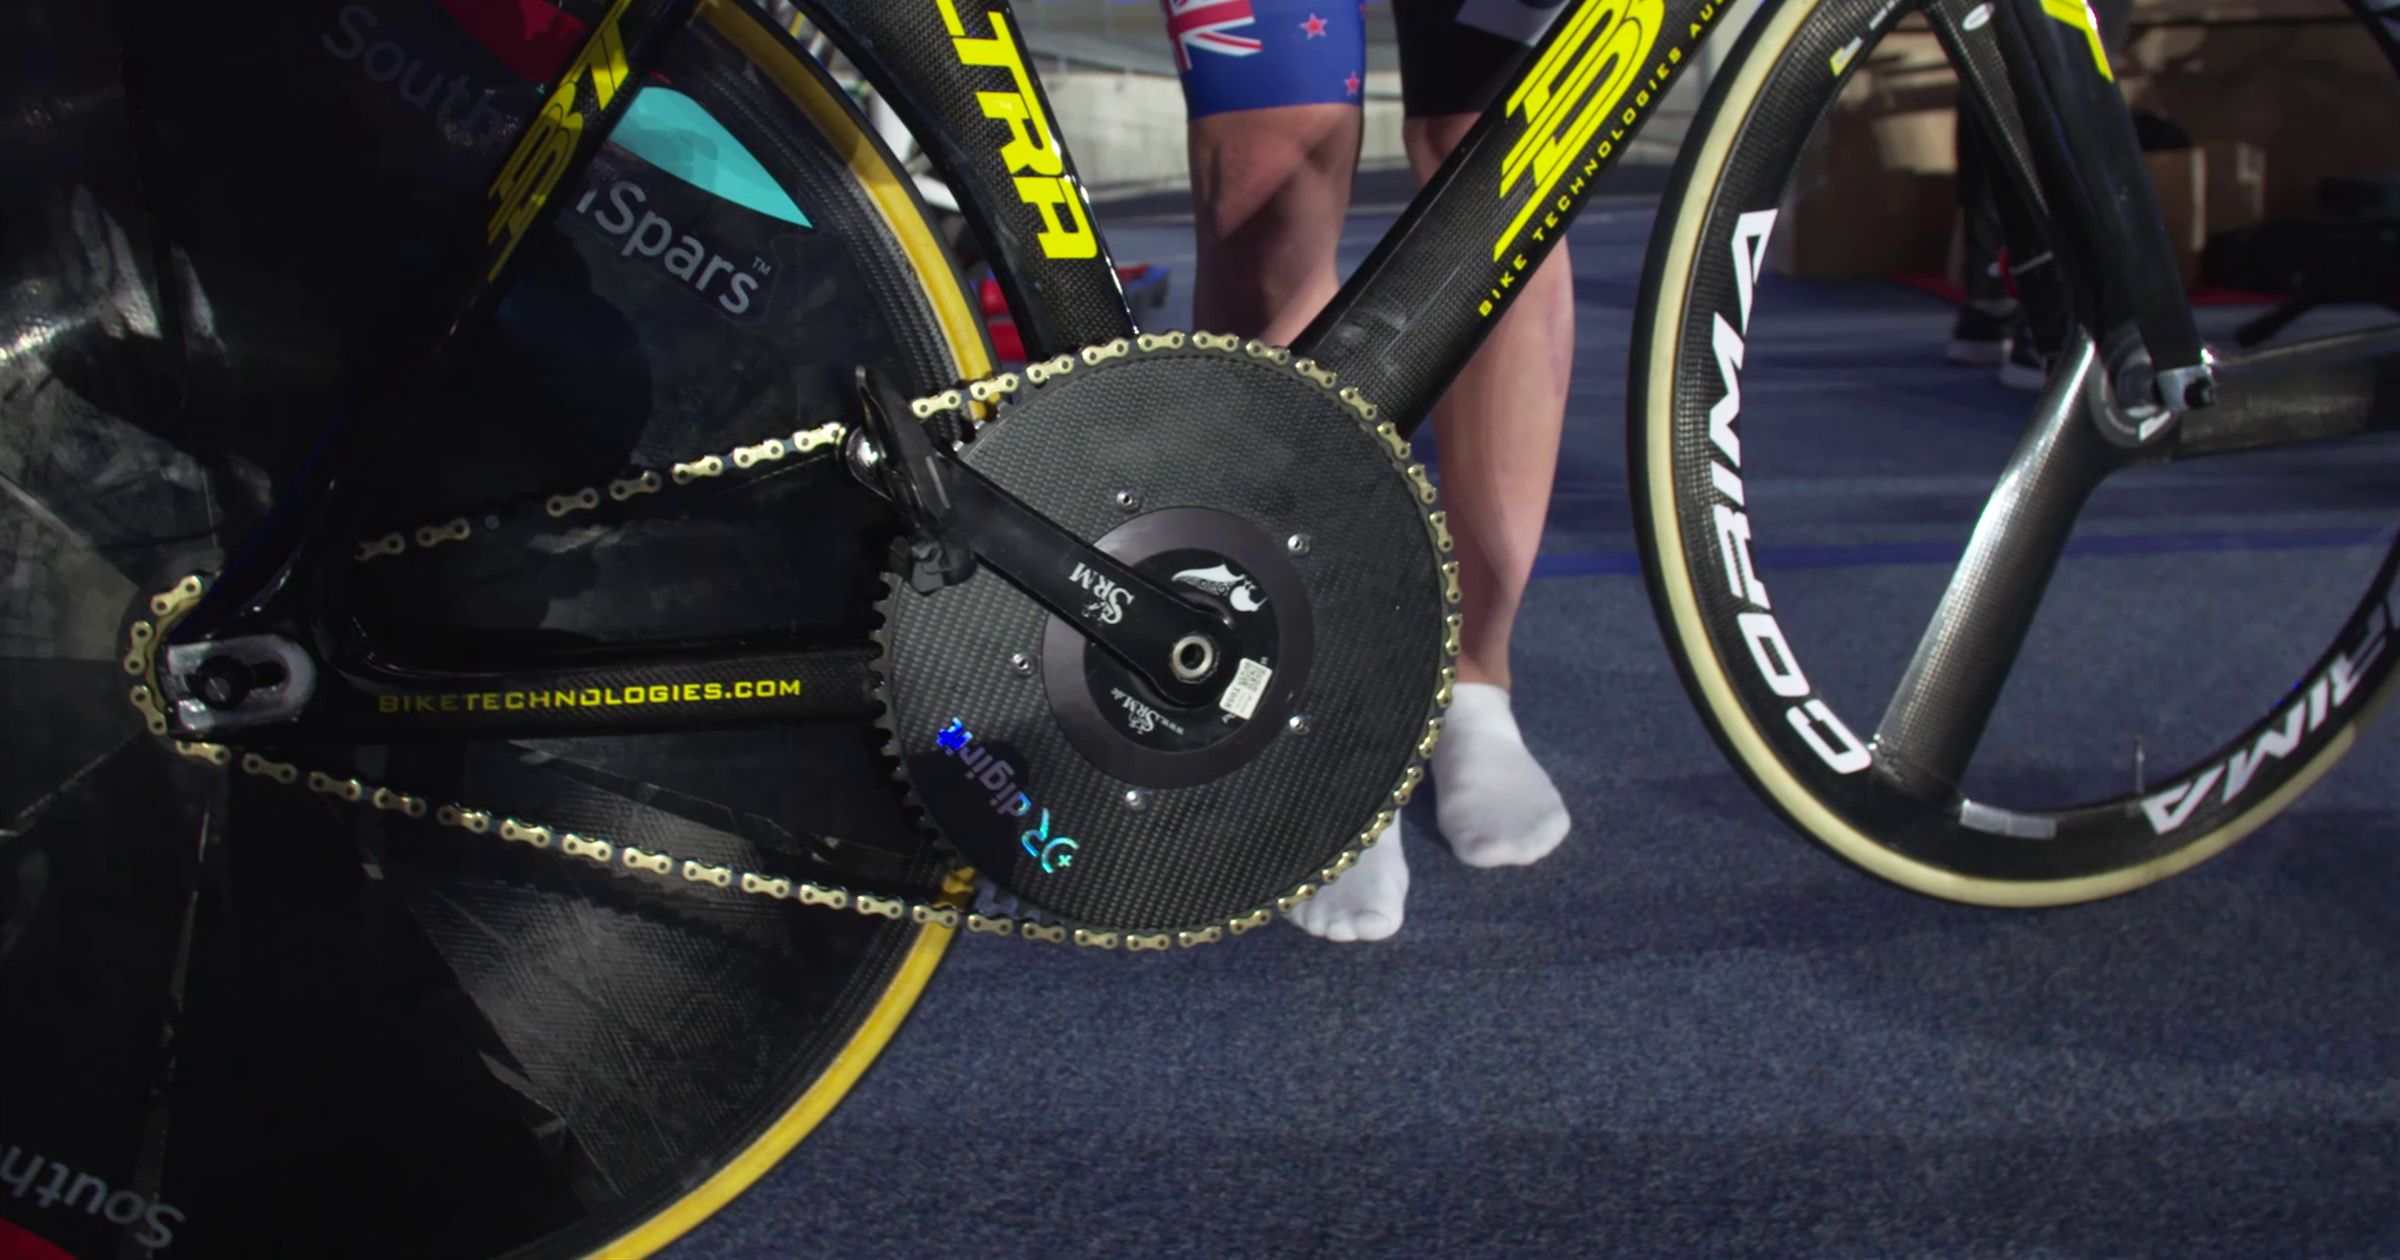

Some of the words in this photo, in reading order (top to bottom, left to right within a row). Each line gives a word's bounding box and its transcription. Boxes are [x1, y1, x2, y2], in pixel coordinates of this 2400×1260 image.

[1479, 254, 1528, 317] BIKE
[1531, 46, 1682, 243] TECHNOLOGIES
[1709, 208, 1872, 774] CORIMA
[1068, 562, 1135, 624] SRM
[379, 679, 801, 714] BIKETECHNOLOGIES.COM
[0, 1146, 186, 1248] South
